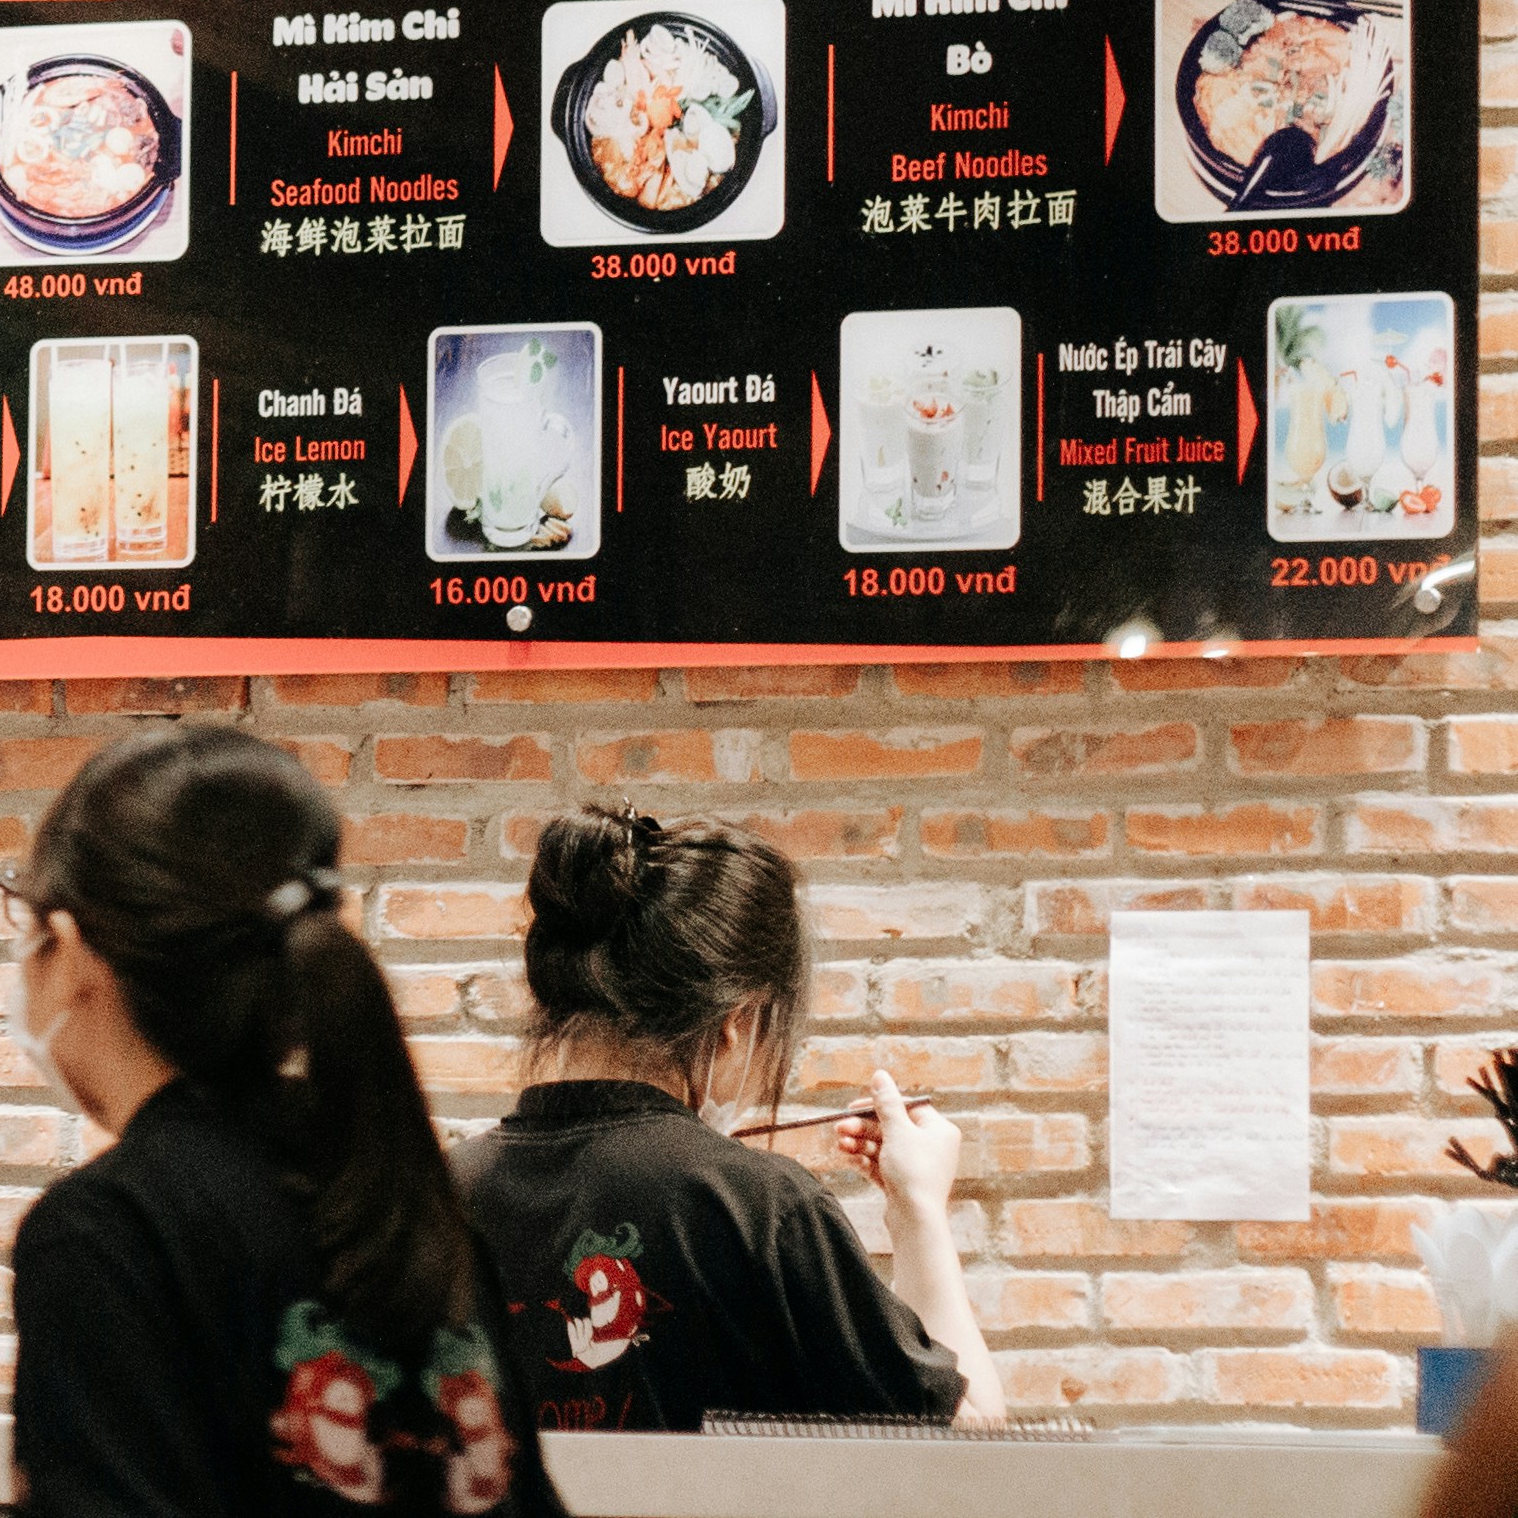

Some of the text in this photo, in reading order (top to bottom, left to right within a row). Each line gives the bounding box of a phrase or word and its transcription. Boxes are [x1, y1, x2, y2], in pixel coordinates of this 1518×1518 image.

[273, 7, 461, 48] Mì Kim Chi
[946, 42, 994, 77] Bò
[298, 67, 433, 105] Hải Sản
[929, 102, 1010, 133] Kimchi
[327, 128, 403, 158] Kimchi
[891, 147, 1048, 182] Beef Noodles
[270, 173, 460, 207] Seafood Noodles
[860, 188, 1079, 235] 泡菜牛肉拉面
[260, 213, 467, 257] 海鲜泡菜拉面
[1207, 224, 1362, 257] 38.000 vnđ
[589, 248, 737, 280] 38.000 vnđ
[4, 271, 144, 300] 48.000 vnđ
[1058, 335, 1228, 376] Nước Ép Trái Cây
[257, 386, 363, 419] Chanh Đá
[661, 372, 776, 408] Yaourt Đá
[1092, 380, 1192, 424] Thập Cẩm
[254, 436, 365, 463] Ice Lemon
[661, 422, 779, 452] Ice Yaourt
[1060, 434, 1226, 466] Mixed Fruit Juice
[258, 472, 359, 512] 柠檬水
[684, 462, 753, 502] 酸奶
[1082, 475, 1203, 516] 混合果汁
[844, 563, 1017, 598] 18.000 vnđ
[1271, 555, 1378, 587] 22.000
[29, 583, 192, 613] 18.000 vnđ
[429, 575, 597, 605] 16.000 vnđ
